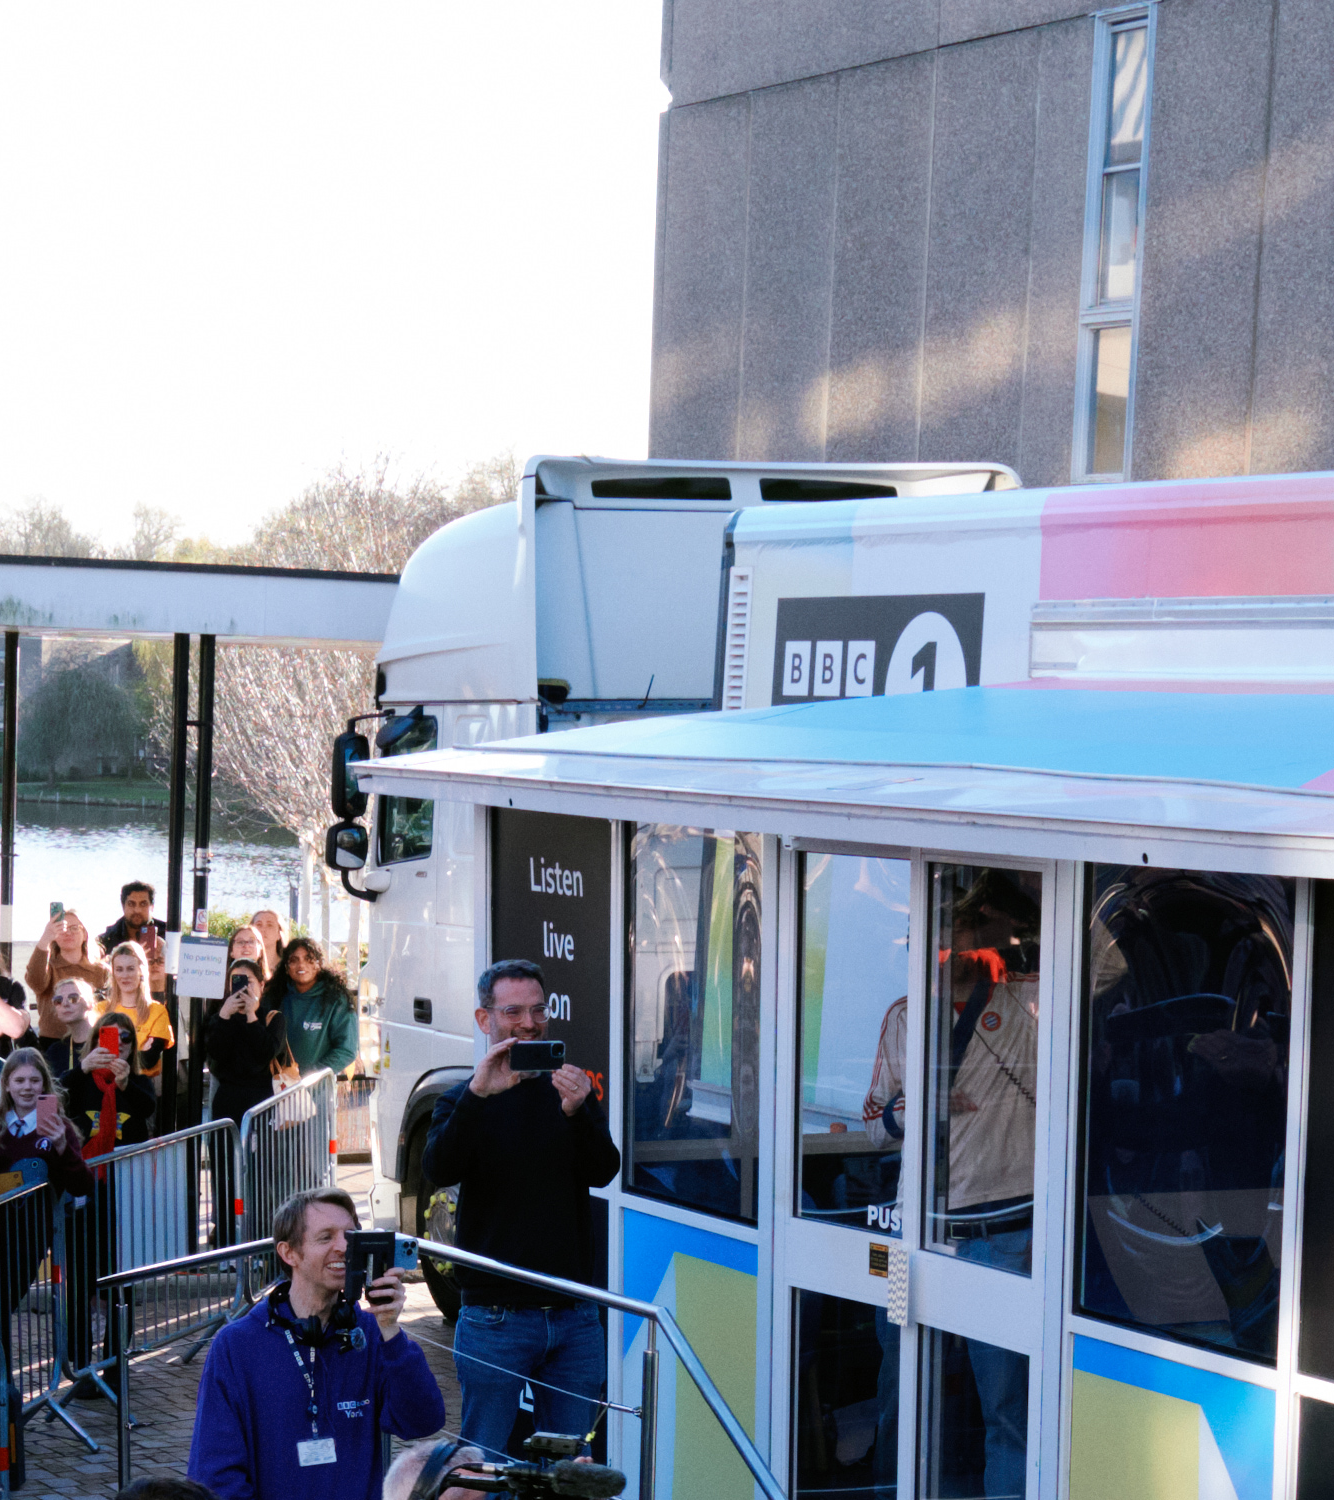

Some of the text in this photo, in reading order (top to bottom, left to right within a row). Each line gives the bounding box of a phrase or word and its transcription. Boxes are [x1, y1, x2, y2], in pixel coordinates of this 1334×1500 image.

[788, 649, 870, 688] BBC
[529, 857, 584, 898] Listen
[543, 921, 575, 961] live
[196, 955, 222, 964] parking
[548, 992, 571, 1022] on
[866, 1204, 902, 1232] PUS
[345, 1408, 364, 1418] York
